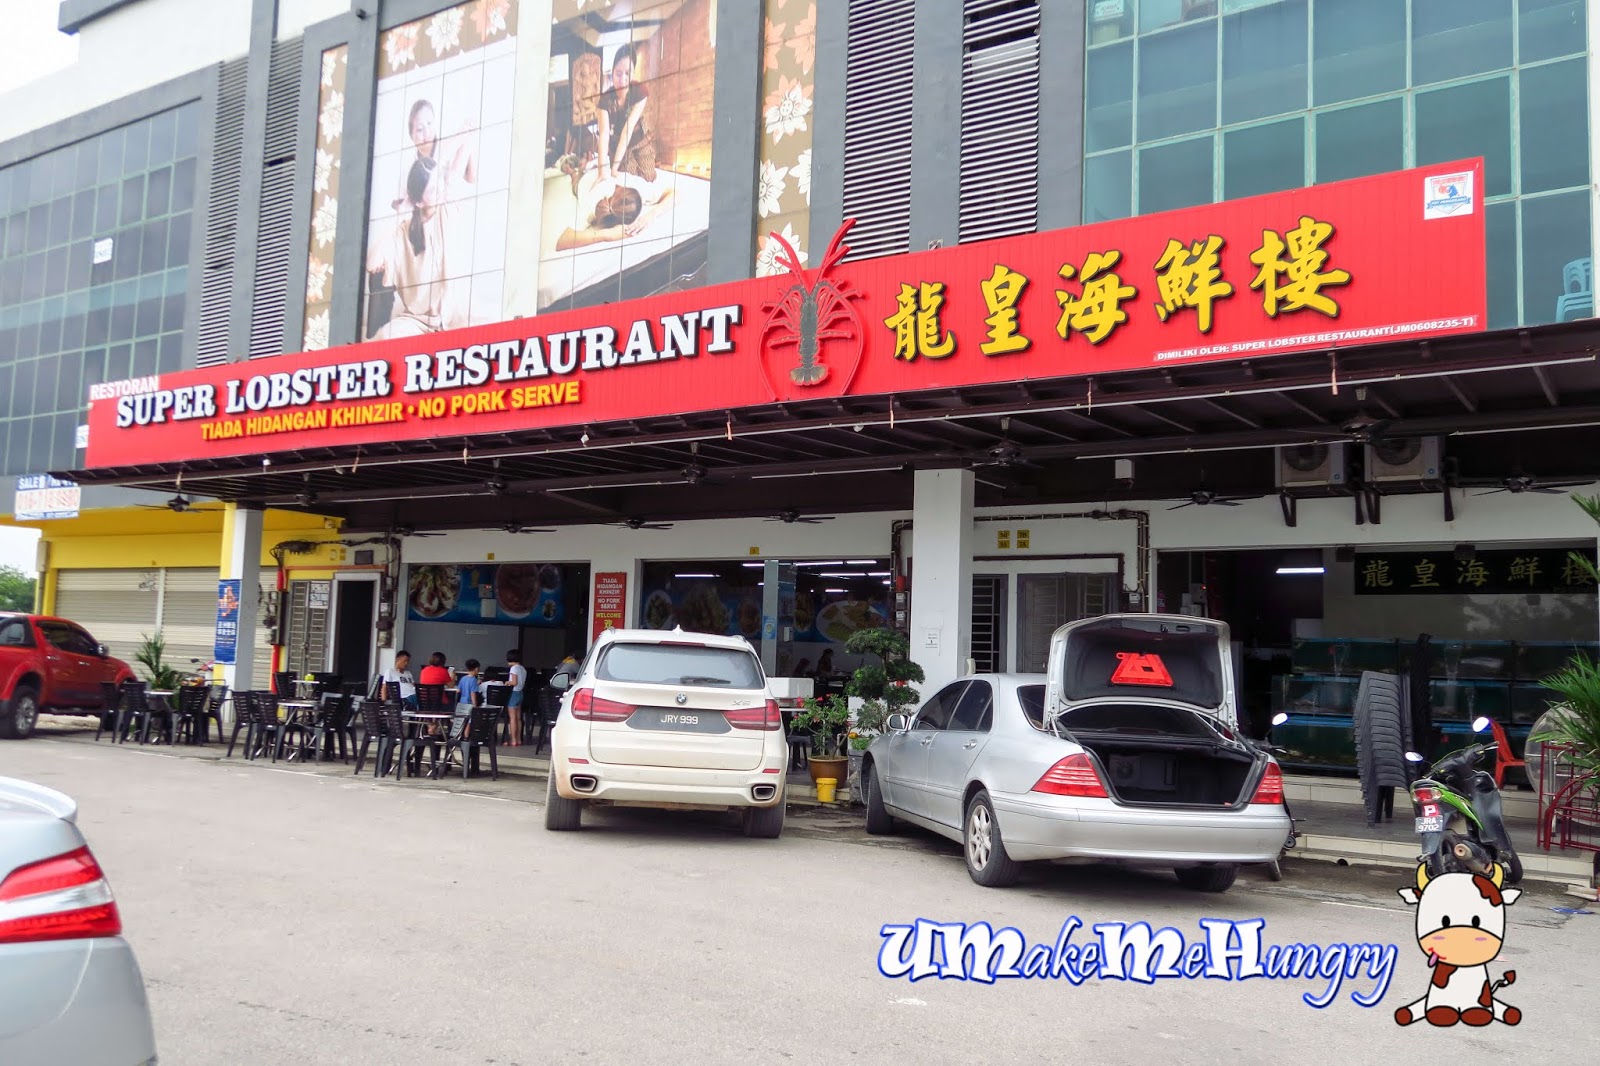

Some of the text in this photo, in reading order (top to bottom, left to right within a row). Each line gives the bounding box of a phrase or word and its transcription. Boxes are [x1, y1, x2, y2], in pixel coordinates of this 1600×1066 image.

[884, 216, 1351, 362] 龍皇海鮮樓
[1157, 348, 1197, 360] DIMILIKI
[1200, 345, 1230, 356] OLEH:
[1232, 341, 1266, 351] SUPER
[1268, 335, 1315, 347] LOBSTER
[116, 304, 741, 428] SUPER LOBSTER RESTAURANT
[90, 376, 159, 400] RESTORAN
[201, 381, 580, 440] TIADA HIDANGAN KHINZIR NO PORK SERVE
[660, 715, 698, 725] JRY 999
[1424, 805, 1437, 817] P
